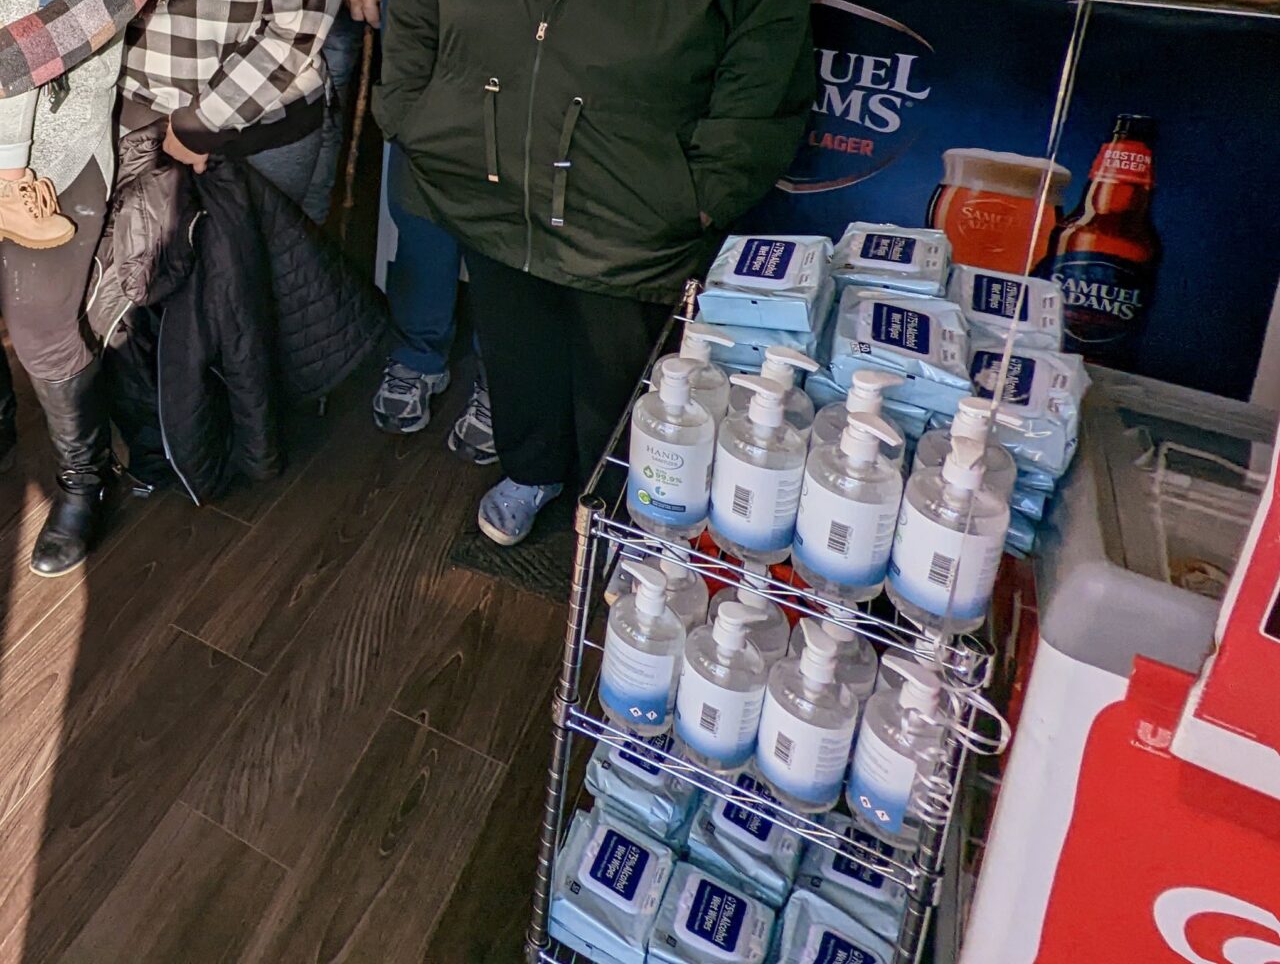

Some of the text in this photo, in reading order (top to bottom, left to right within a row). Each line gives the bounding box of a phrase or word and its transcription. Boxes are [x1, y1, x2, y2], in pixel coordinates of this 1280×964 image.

[814, 47, 932, 100] UEL
[811, 84, 902, 134] MS
[808, 130, 874, 156] LAGER
[1105, 149, 1152, 164] BOSTON
[1105, 158, 1147, 172] LAGER
[1051, 273, 1142, 307] SAMUEL
[1063, 292, 1134, 320] DAMS
[646, 445, 680, 460] HAND
[655, 472, 683, 484] 99.9%
